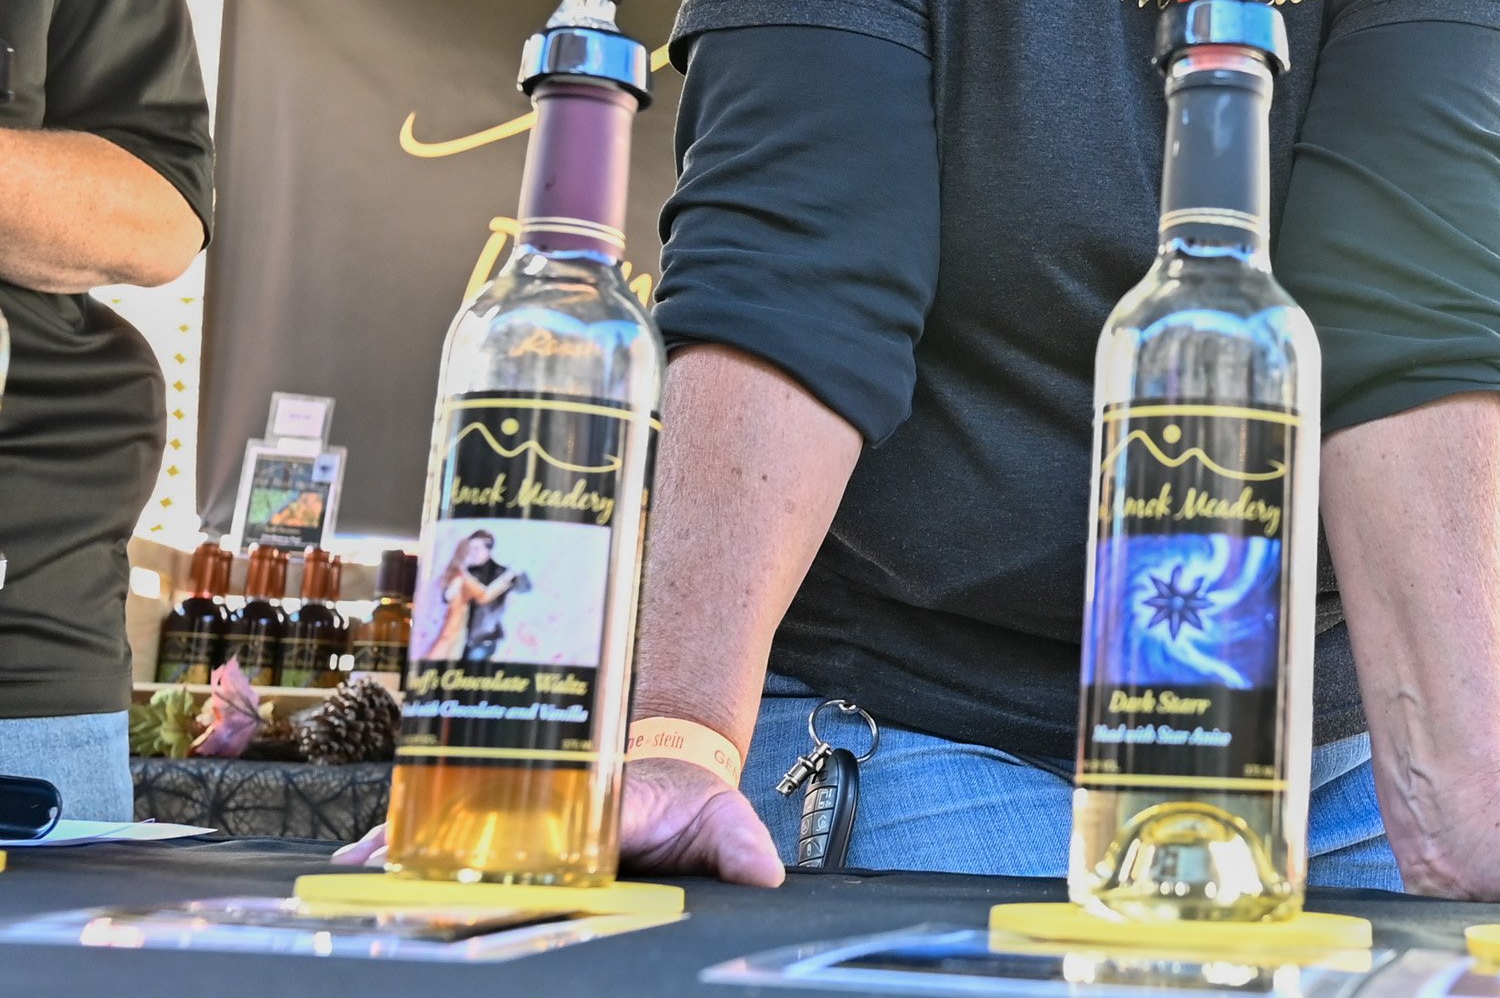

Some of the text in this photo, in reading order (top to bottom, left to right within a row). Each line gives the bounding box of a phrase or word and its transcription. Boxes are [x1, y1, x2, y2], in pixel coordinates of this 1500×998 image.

[506, 477, 615, 526] Meadery
[1173, 486, 1282, 537] Meadery
[1107, 688, 1156, 714] Dark
[652, 730, 685, 750] stein
